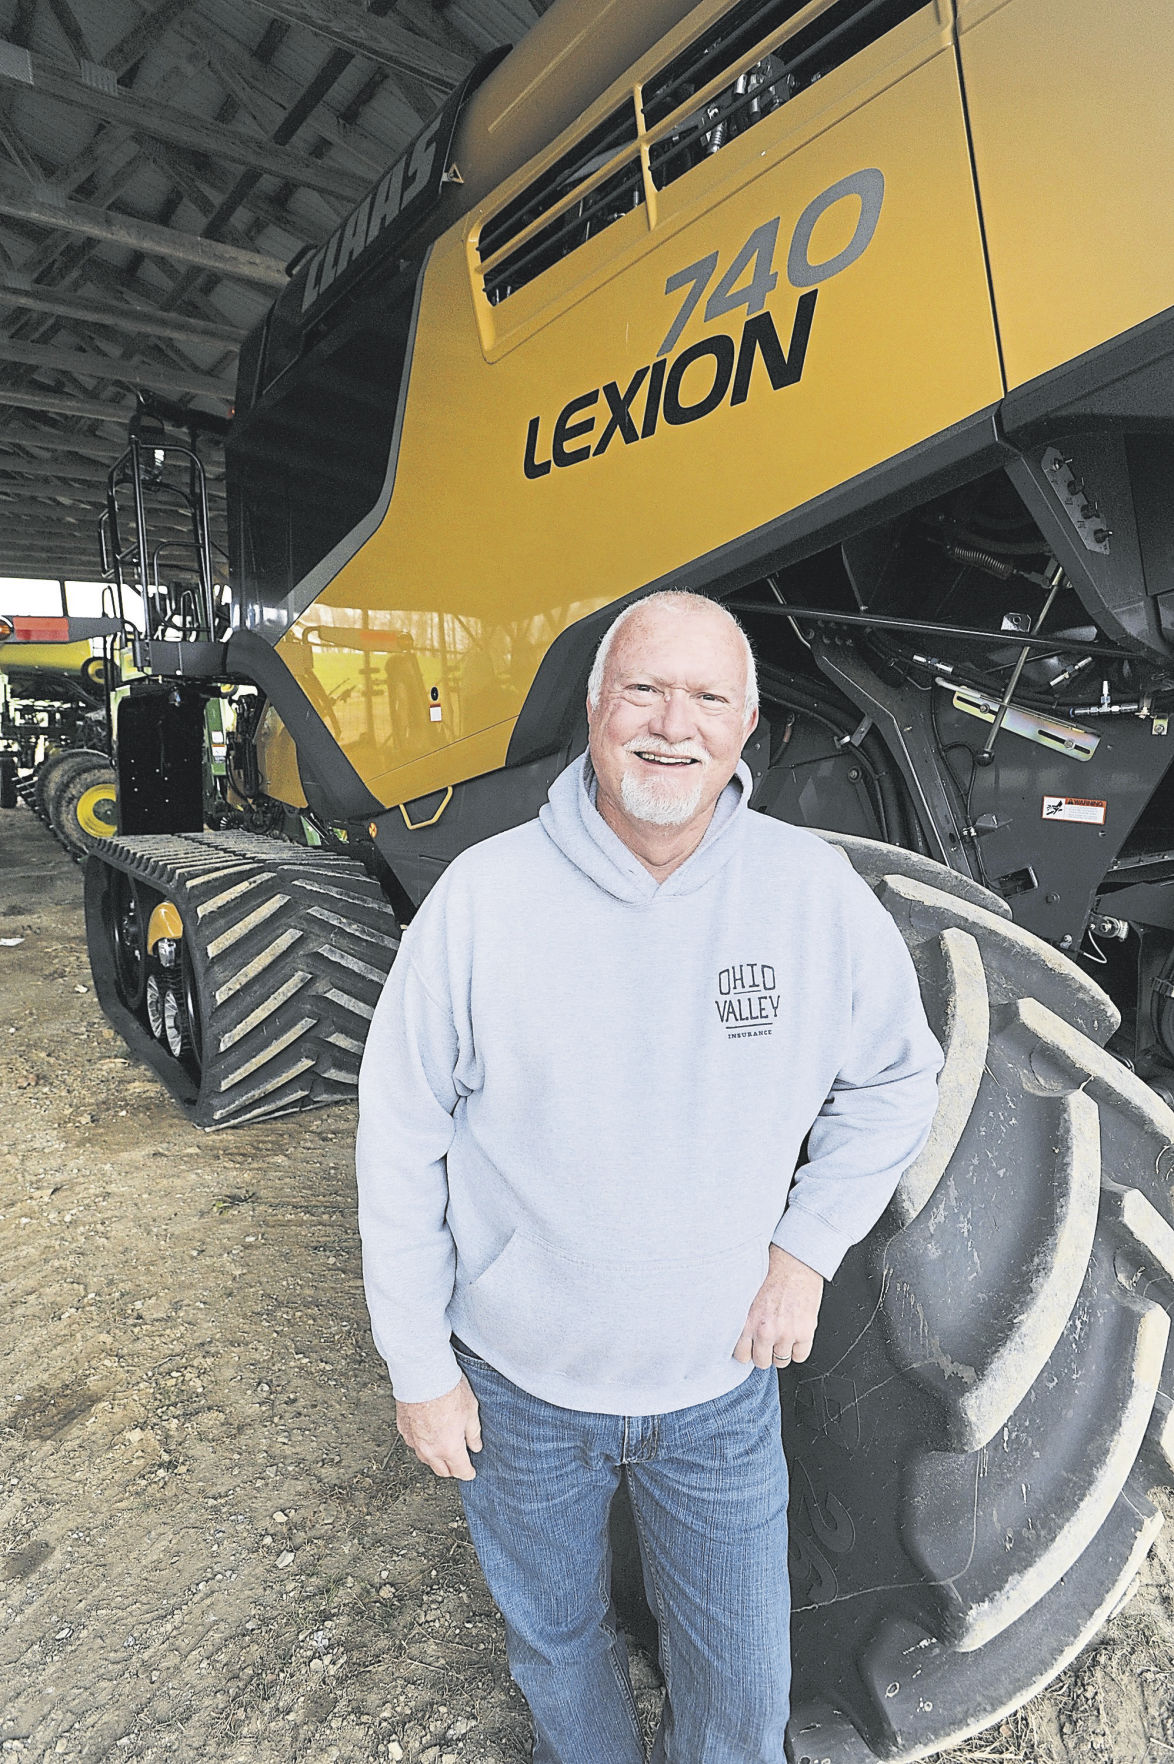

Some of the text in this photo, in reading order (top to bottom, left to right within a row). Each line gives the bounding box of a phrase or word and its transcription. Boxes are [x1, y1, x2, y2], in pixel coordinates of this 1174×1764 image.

[301, 113, 443, 313] CLAAS
[657, 168, 885, 357] 740
[524, 288, 818, 480] LEXION
[715, 995, 780, 1023] VALLEY
[718, 963, 776, 995] OHIO
[728, 1029, 773, 1039] INSURANCE
